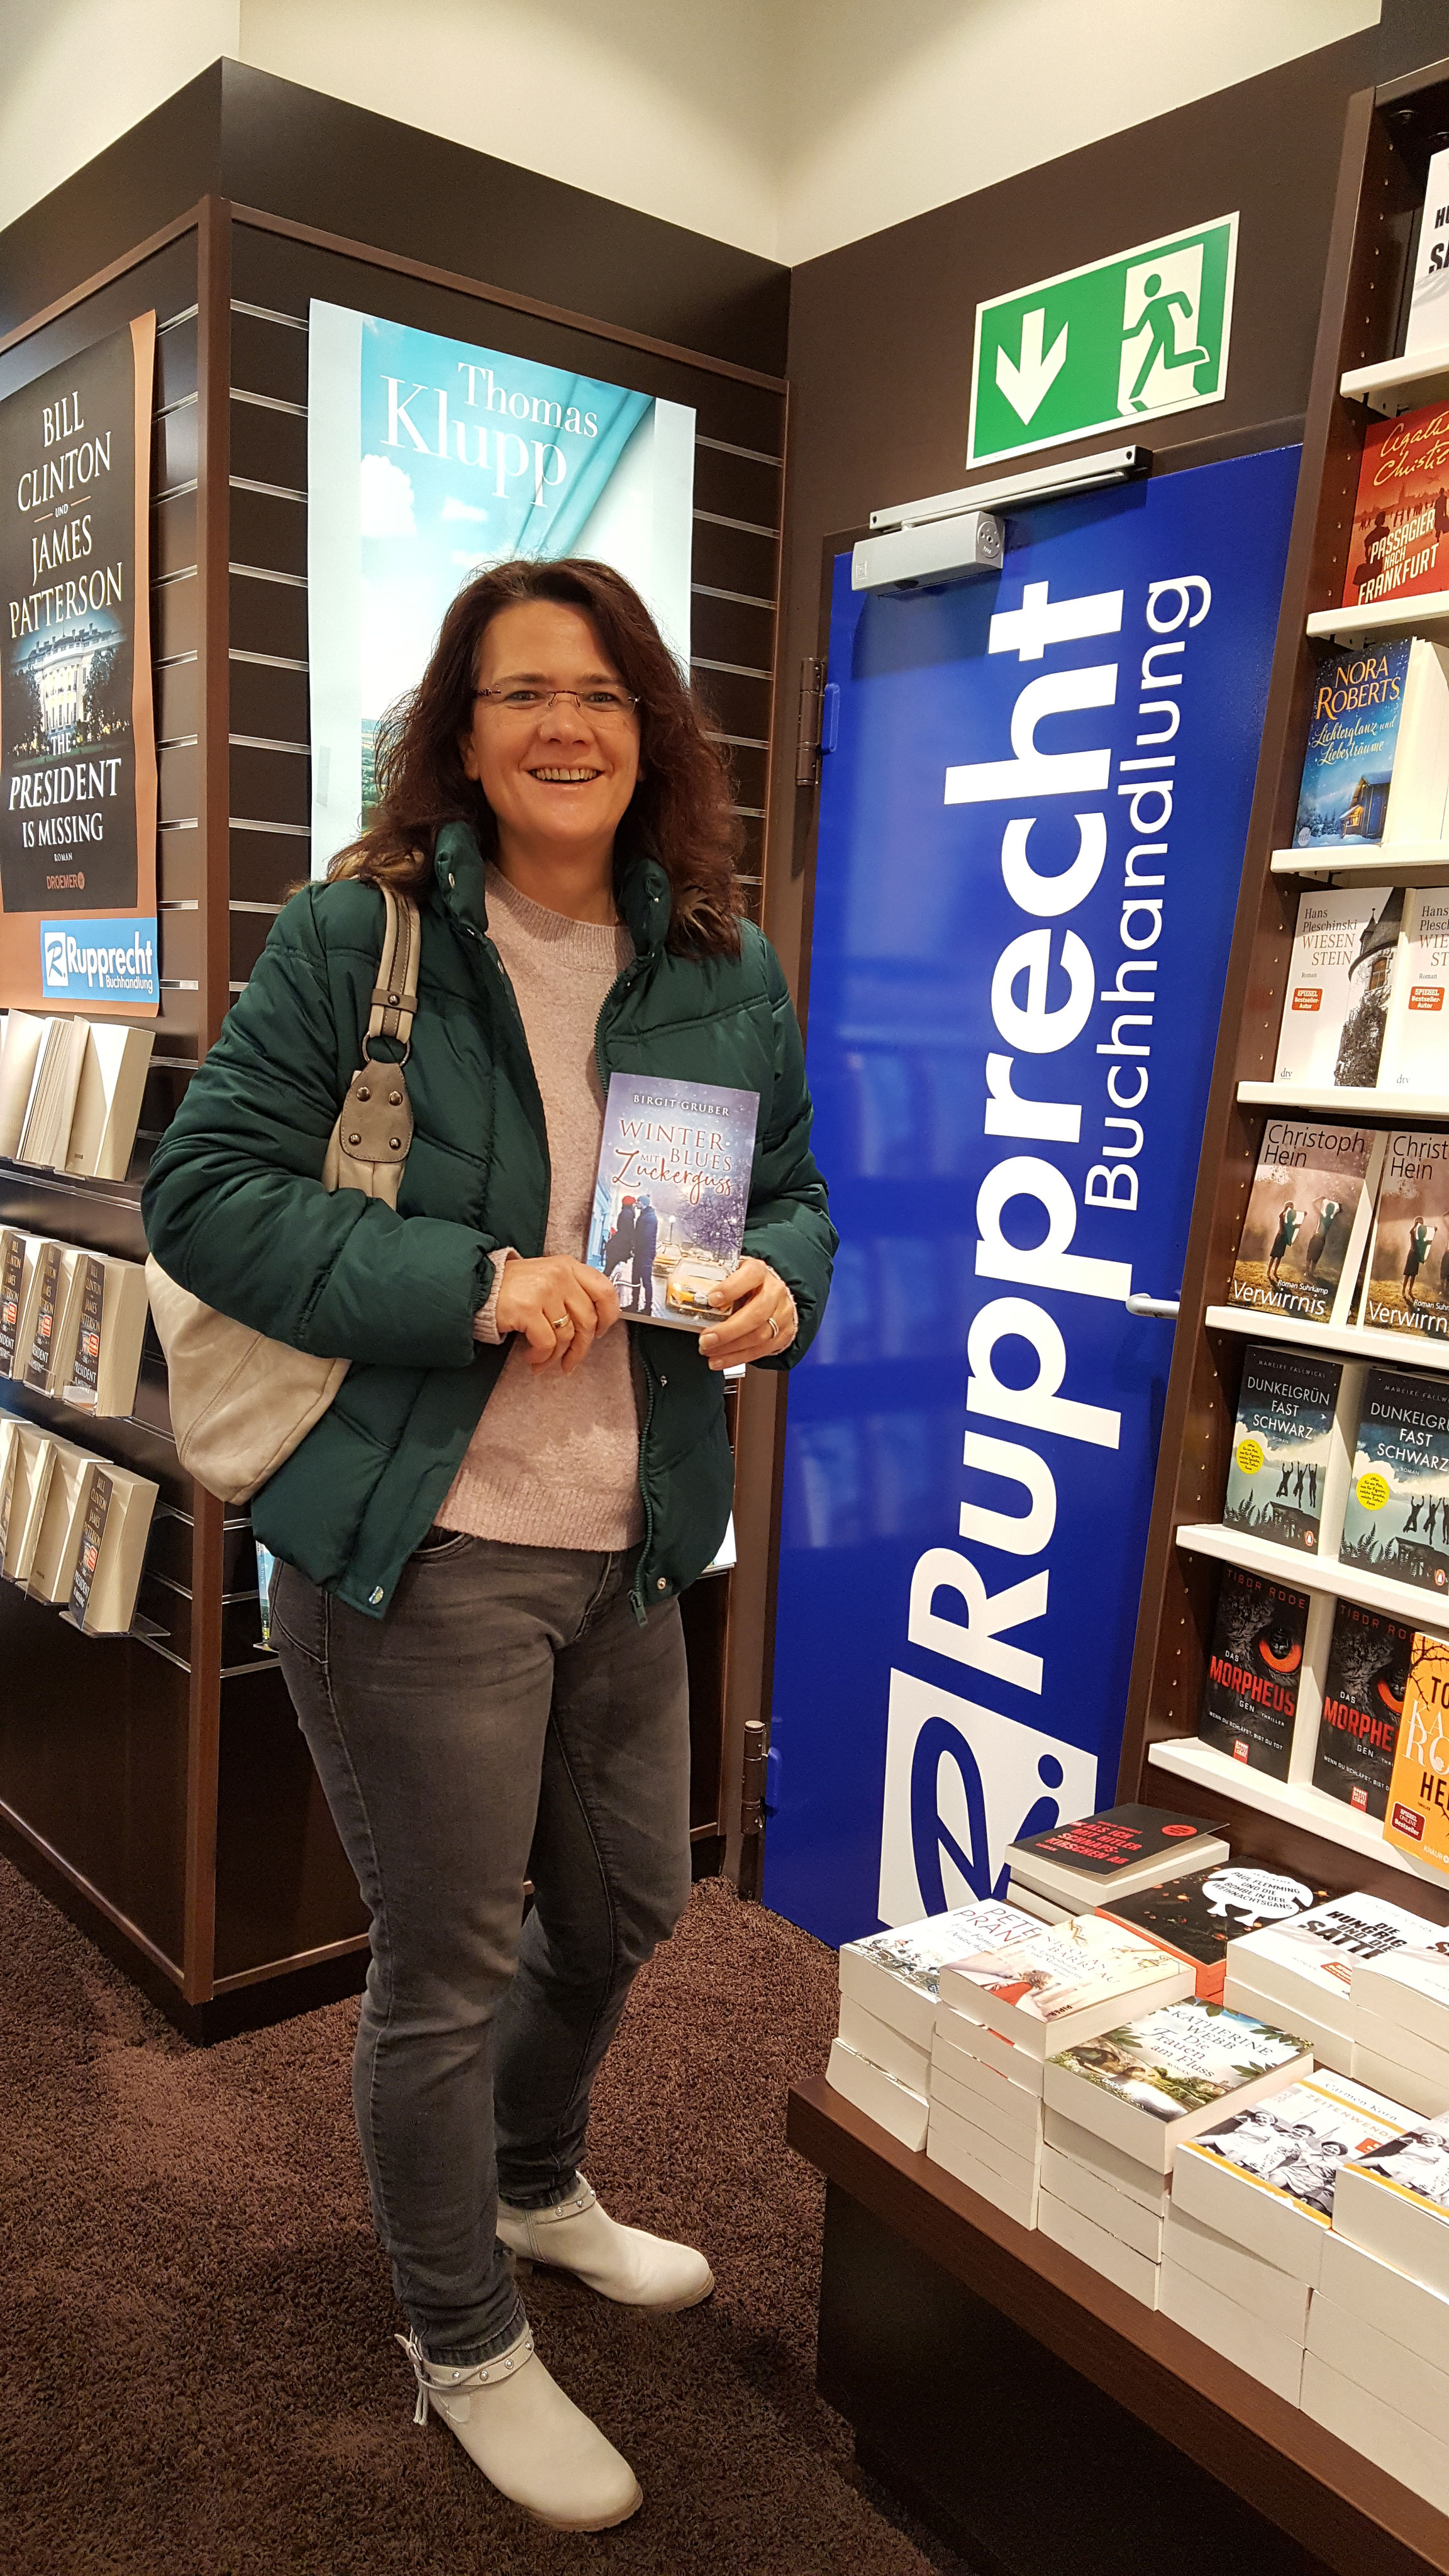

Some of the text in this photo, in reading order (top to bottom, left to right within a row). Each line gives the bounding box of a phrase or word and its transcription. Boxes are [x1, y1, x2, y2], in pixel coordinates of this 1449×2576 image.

[457, 361, 598, 438] Thomas
[42, 391, 84, 448] BILL
[379, 374, 567, 508] Klupp
[18, 431, 112, 512] CLINTON
[1374, 440, 1449, 487] Christie
[55, 502, 69, 518] UND
[1370, 508, 1436, 564] PASSAGIER
[31, 514, 92, 587] JAMES
[1384, 546, 1406, 570] NACH
[1358, 543, 1439, 606] FRANKFURT
[9, 562, 123, 638] PATTERSON
[1335, 655, 1389, 689] NORA
[1316, 677, 1401, 721] ROBERTS
[1311, 716, 1397, 748] Lichterglanz und
[51, 732, 72, 756] THE
[1317, 740, 1384, 766] Liebesträume
[9, 758, 121, 811] PRESIDENT
[22, 813, 103, 848] IS MISSING
[54, 852, 73, 862] ROMAN
[47, 875, 77, 889] DROEMER
[1085, 575, 1212, 1211] Buchhandlung
[1305, 908, 1328, 919] Hans
[1421, 906, 1448, 918] Hans
[1302, 919, 1358, 932] Pleschinski
[1302, 933, 1355, 949] WIESEN
[1419, 934, 1448, 949] WIE
[67, 931, 153, 988] Rupprecht
[1312, 952, 1353, 965] STEIN
[106, 975, 153, 994] Buchhandlung
[1280, 1068, 1293, 1077] dtv
[1396, 1074, 1411, 1084] dtv
[633, 1094, 730, 1116] BIRGIT GRUBER
[619, 1119, 725, 1152] WINTER
[908, 580, 1133, 1695] Rupprecht
[1269, 1124, 1365, 1156] Christoph
[640, 1154, 659, 1163] MIT
[1264, 1144, 1307, 1167] Hein
[1392, 1135, 1449, 1160] Christ
[670, 1148, 731, 1172] BLUES
[1390, 1157, 1433, 1180] Hein
[612, 1148, 735, 1205] Zuckerguss
[1233, 1280, 1326, 1316] Verwirrnis
[1277, 1279, 1328, 1295] Roman Suhrkamp
[1414, 1299, 1435, 1308] Roman
[1369, 1301, 1448, 1333] Verwirrn
[74, 1360, 96, 1384] PRESIDENT
[1258, 1360, 1326, 1379] MAREIKE FALLWICKL
[1247, 1376, 1330, 1406] DUNKELGRÜN
[1384, 1385, 1418, 1397] MAREIKE
[1271, 1400, 1299, 1417] FAST
[1253, 1414, 1313, 1441] SCHWARZ
[1399, 1428, 1433, 1447] FAST
[1377, 1443, 1449, 1472] SCHWARZ
[1400, 1467, 1419, 1476] ROMAN
[91, 1488, 108, 1511] CLINTON
[89, 1509, 101, 1529] JAMES
[74, 1570, 90, 1598] PRESIDENT
[1227, 1569, 1306, 1609] TIBOR RODE
[1340, 1604, 1379, 1628] TIBOR
[1225, 1650, 1240, 1662] DAS
[1209, 1656, 1296, 1717] MORPHEUS
[1340, 1691, 1356, 1704] DAS
[1240, 1700, 1255, 1713] GEN
[1209, 1711, 1221, 1721] WENN
[1253, 1733, 1264, 1741] BIST
[1273, 1742, 1283, 1750] TOT
[1261, 1713, 1285, 1726] THRILLER
[1357, 1744, 1374, 1758] GEN
[1324, 1755, 1338, 1766] WENN
[1373, 1779, 1384, 1789] BIST
[1394, 1818, 1419, 1836] Bestseller
[1399, 1814, 1417, 1827] ONLINE
[1400, 1809, 1418, 1823] SPIEGEL
[1057, 1833, 1118, 1853] SCHNAPS-
[1070, 1828, 1143, 1851] MIT HITLER
[1082, 1824, 1110, 1833] ALS
[1108, 1830, 1135, 1840] ICH
[1045, 1837, 1109, 1859] KIRSCHEN
[1424, 1844, 1443, 1860] KNAUR
[1224, 1882, 1253, 1896] BOMBE
[1231, 1871, 1252, 1881] PAUL
[1252, 1879, 1301, 1894] FLEMMING
[1241, 1882, 1260, 1892] UND
[1212, 1882, 1293, 1910] WEIHNACHTSGANS
[953, 1909, 1022, 1941] PRAN
[1325, 1910, 1408, 1948] HUNGRIG
[1336, 1923, 1367, 1940] UND
[1374, 1922, 1401, 1935] DIE
[1049, 2004, 1074, 2018] PIPER
[1140, 2027, 1206, 2060] Frauen
[1170, 2010, 1274, 2057] KATHERINE
[1182, 2035, 1210, 2050] Die
[1187, 2024, 1238, 2050] WEBB
[1150, 2045, 1214, 2077] am Fluss
[1167, 2062, 1191, 2075] ROMAN
[1326, 2083, 1398, 2121] Carmen Korn
[1306, 2094, 1396, 2141] ZEITENWENDE
